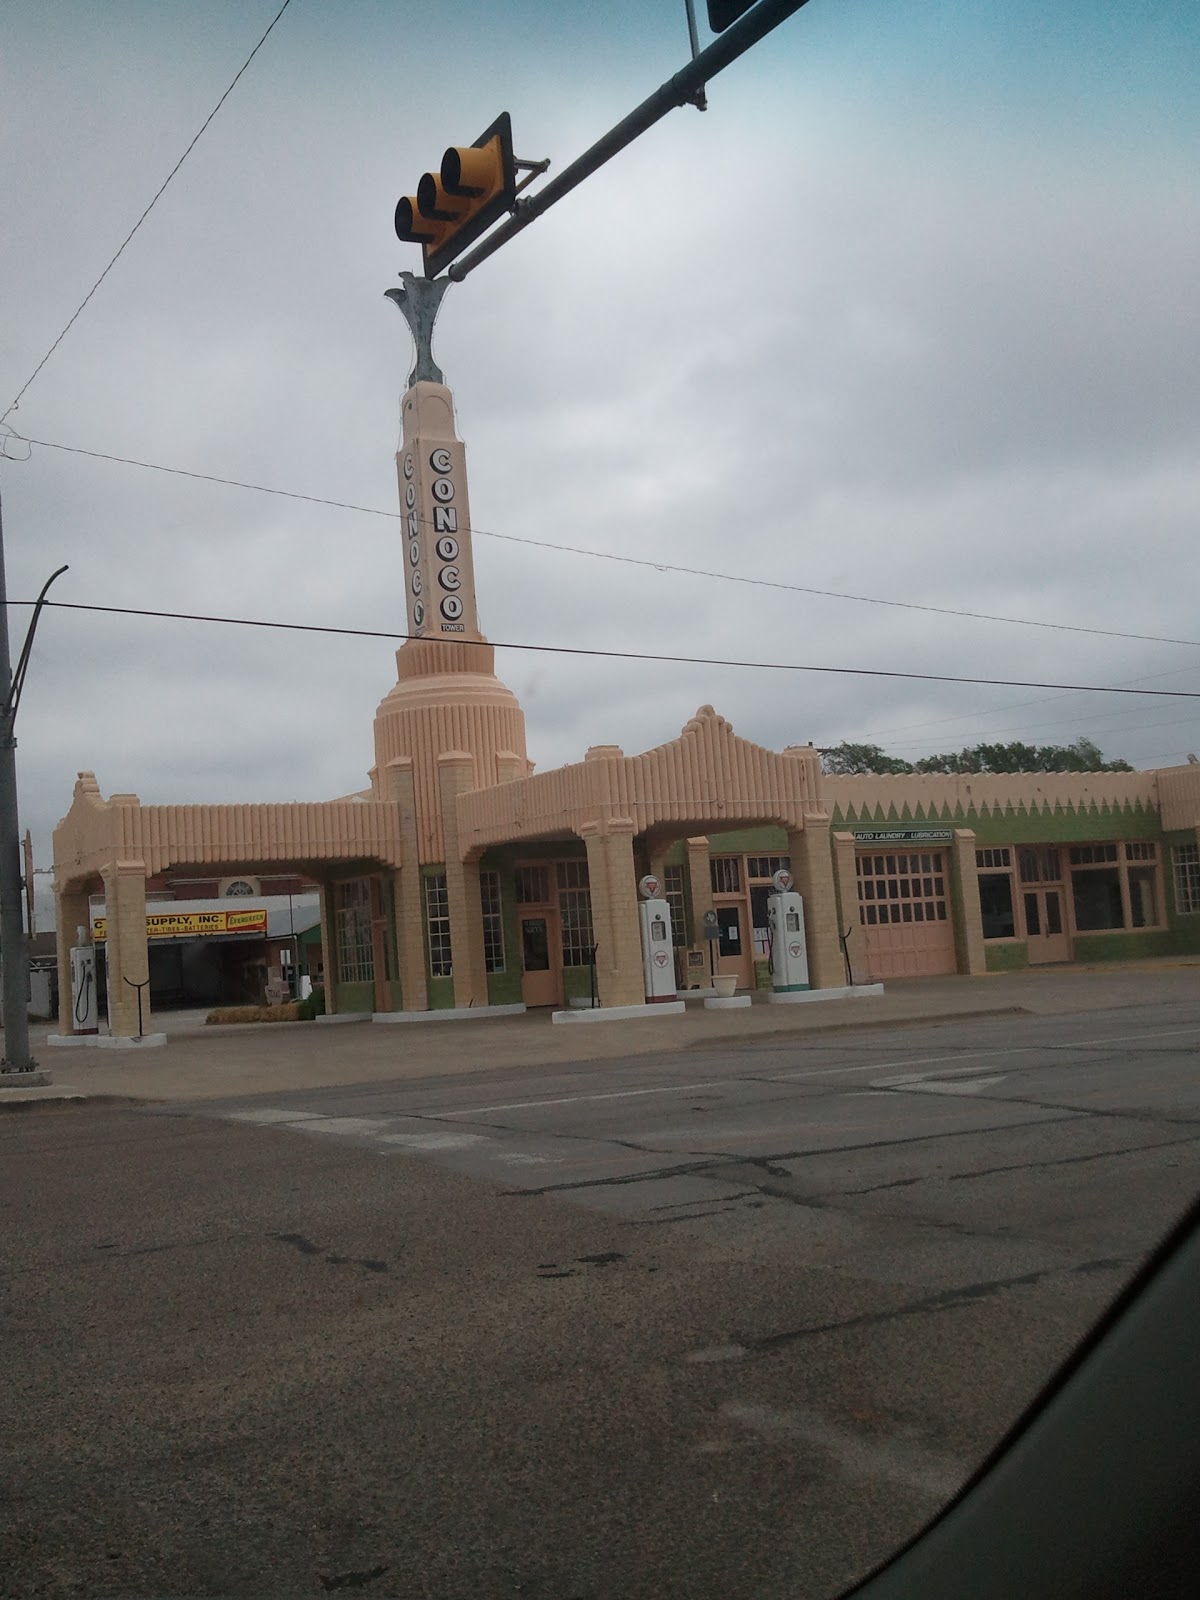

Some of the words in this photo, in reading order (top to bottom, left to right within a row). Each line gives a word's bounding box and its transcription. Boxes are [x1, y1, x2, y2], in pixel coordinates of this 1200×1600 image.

[403, 452, 425, 626] CONOCO
[429, 448, 464, 622] CONOCO
[442, 624, 464, 632] TOWER
[856, 832, 874, 840] AUTO
[875, 832, 906, 840] LAUNDRY
[910, 831, 950, 839] LUBRICATION
[198, 915, 223, 924] INC.
